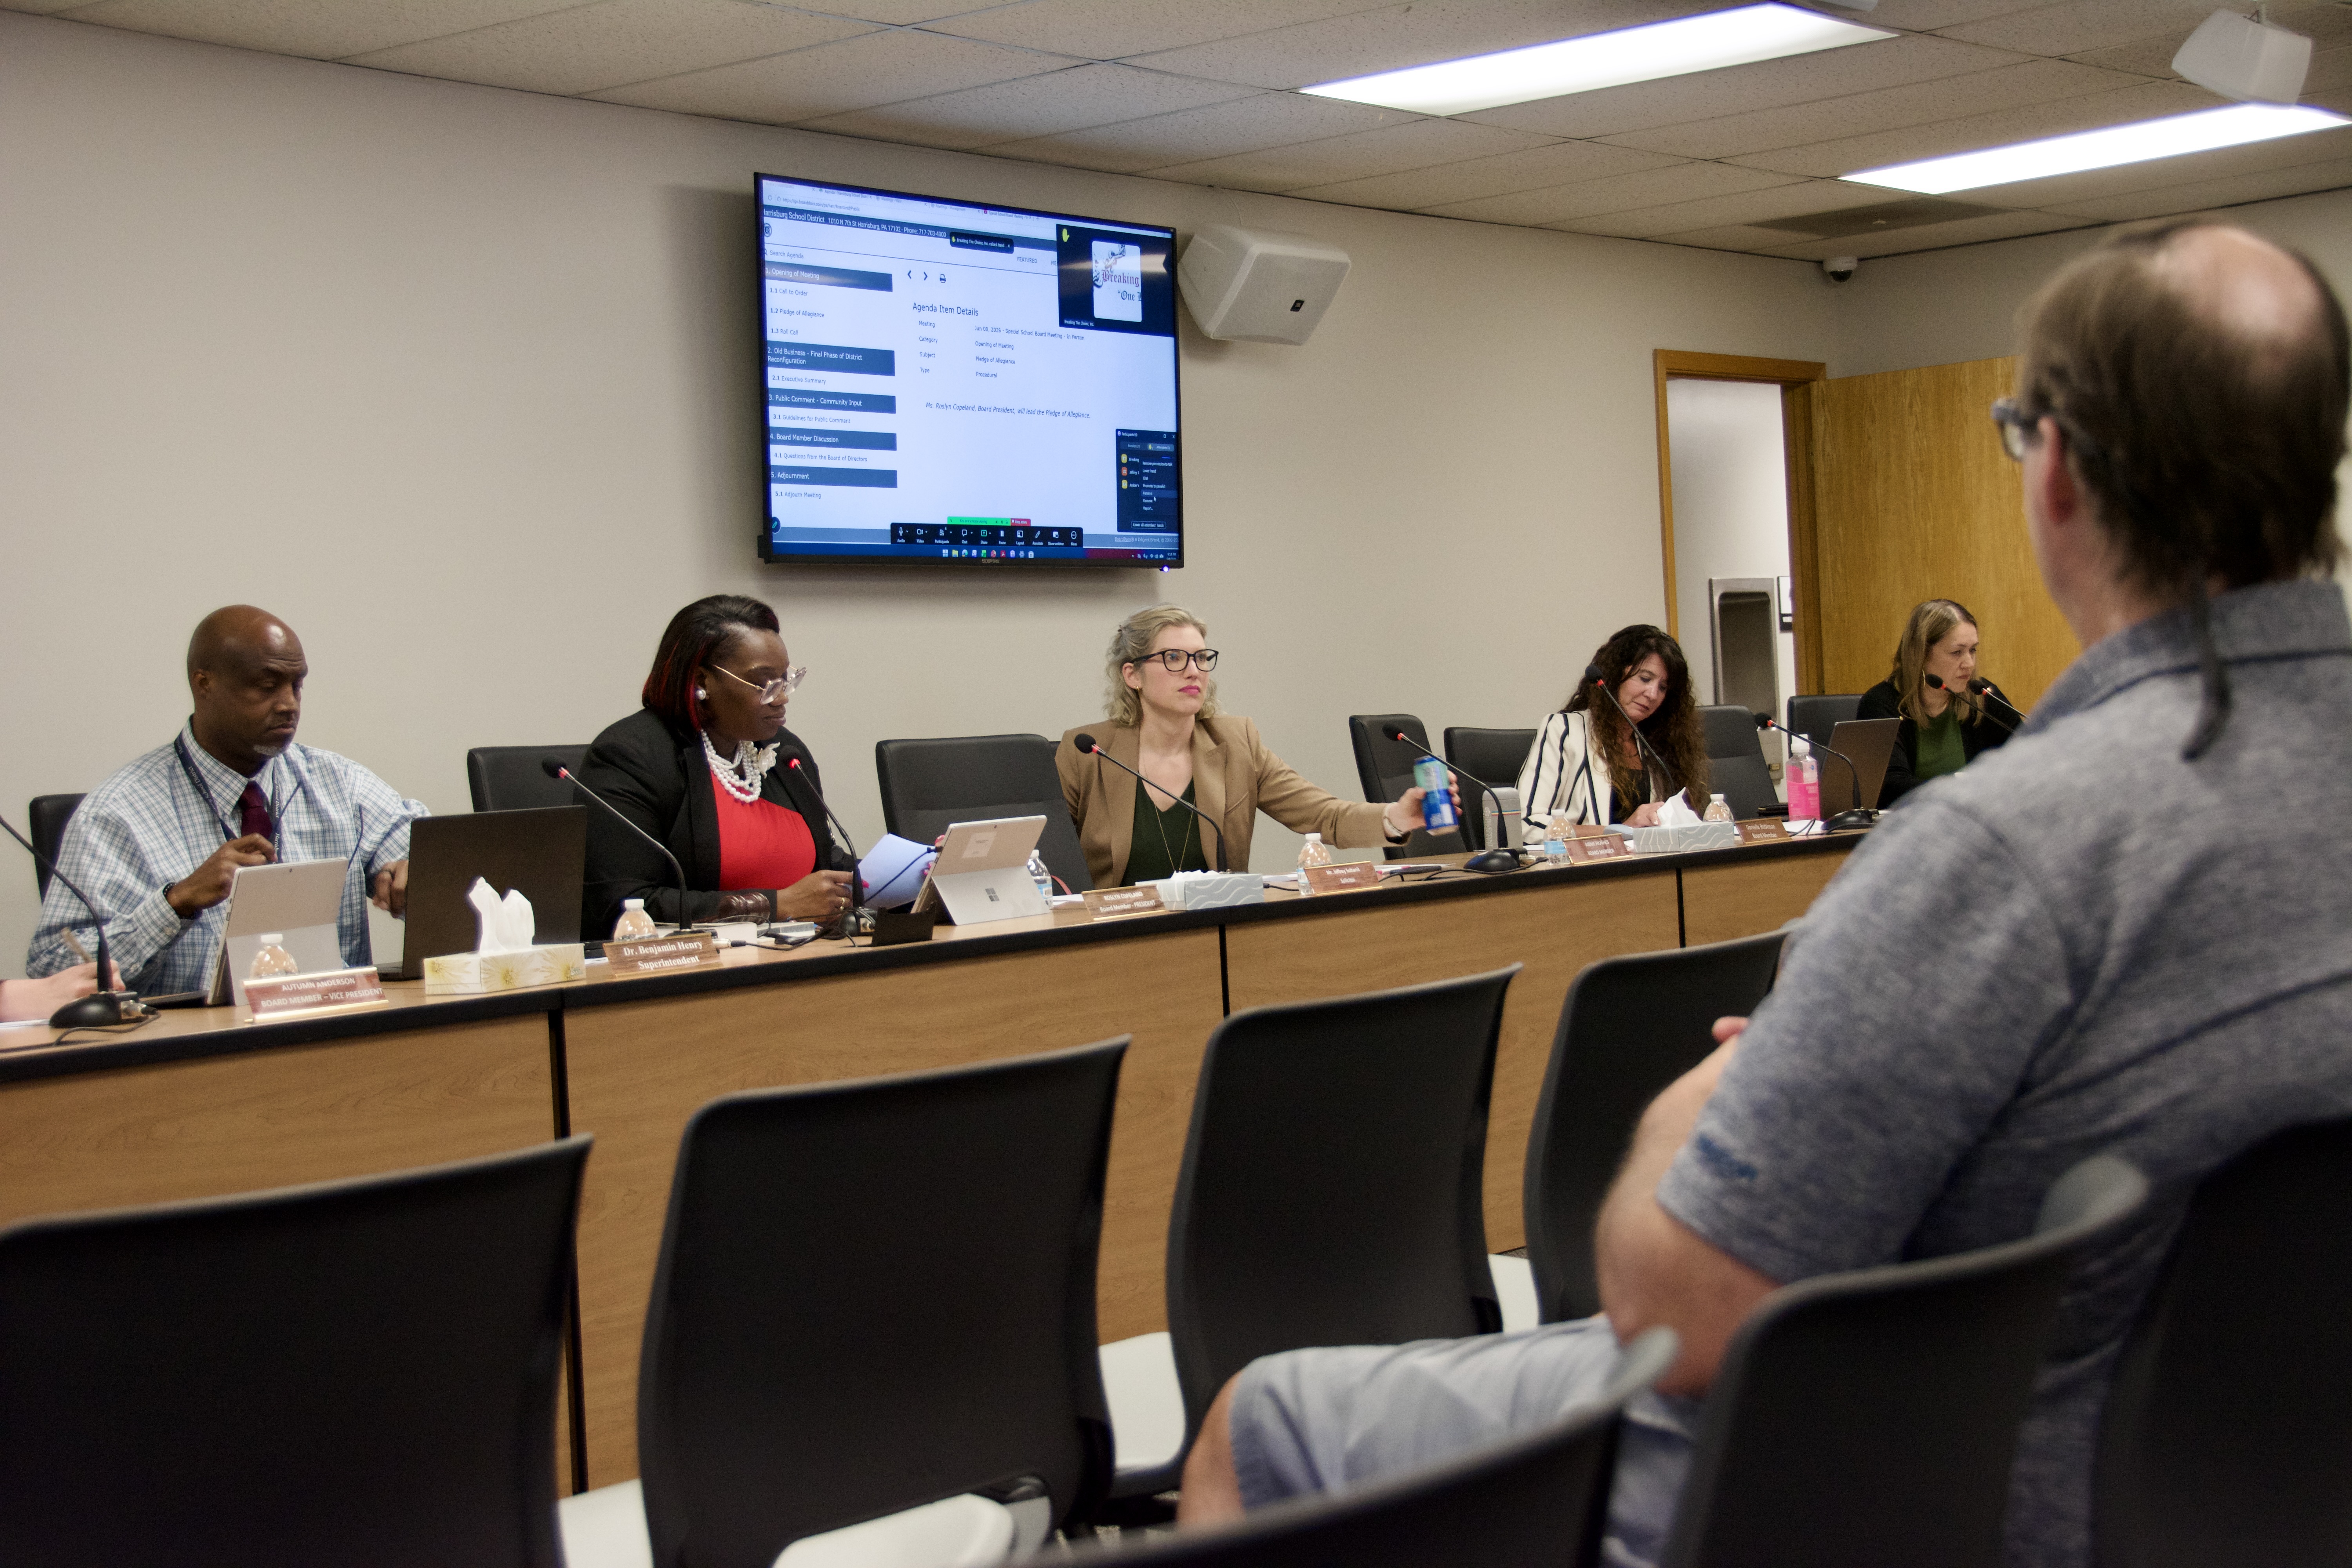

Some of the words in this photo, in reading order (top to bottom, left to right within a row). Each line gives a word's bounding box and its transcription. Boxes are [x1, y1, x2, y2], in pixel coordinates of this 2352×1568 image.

[789, 212, 806, 220] School
[807, 214, 825, 223] District
[857, 222, 881, 231] Harrisburg,
[919, 229, 947, 238] 717-703-4000
[772, 268, 793, 278] Opening
[800, 271, 819, 280] Meeting
[1102, 269, 1140, 287] Breaking
[913, 302, 937, 312] Agenda
[940, 305, 955, 314] Item
[957, 307, 978, 316] Details
[784, 348, 806, 356] Business
[768, 356, 806, 365] Reconfiguration
[820, 397, 848, 407] Community
[953, 404, 976, 412] Copeland,
[623, 947, 638, 956] Dr.
[639, 942, 677, 955] Benjamin
[677, 940, 703, 950] Henry
[638, 955, 700, 970] Superintendent
[282, 982, 316, 991] AUTUMN
[316, 977, 356, 988] ANDERSON
[261, 998, 288, 1007] BOARD
[289, 993, 323, 1005] MEMBER
[328, 991, 344, 1000] VICE
[345, 987, 383, 999] PRESIDENT
